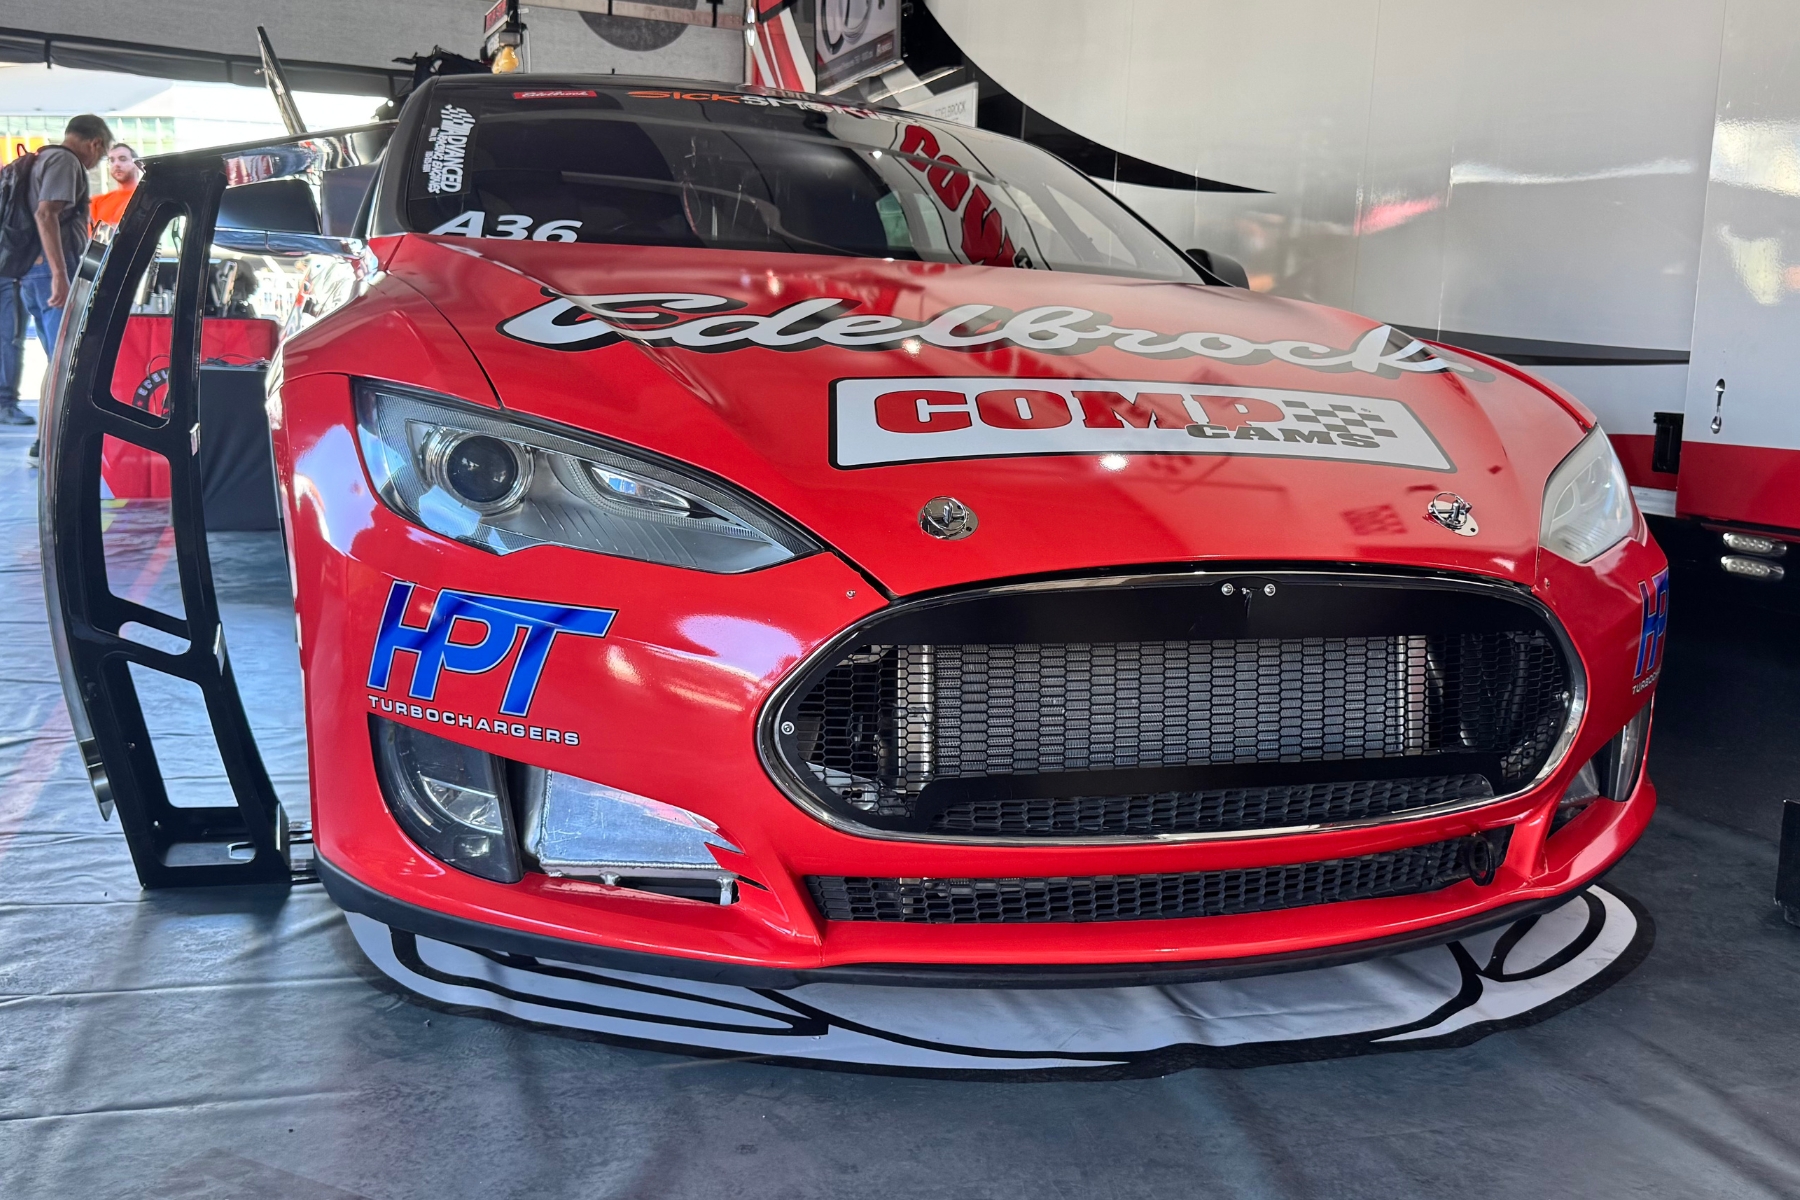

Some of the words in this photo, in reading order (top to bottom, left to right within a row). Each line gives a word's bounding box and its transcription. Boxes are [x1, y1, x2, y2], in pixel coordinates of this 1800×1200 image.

[440, 124, 473, 193] ADVANCED
[428, 210, 583, 243] A36
[497, 287, 1495, 381] Edelbrock
[875, 389, 1286, 434] COMP
[1185, 423, 1381, 449] CAMS
[366, 579, 619, 718] HPT
[1633, 566, 1669, 681] HP
[368, 694, 580, 746] TURBOCHARGERS
